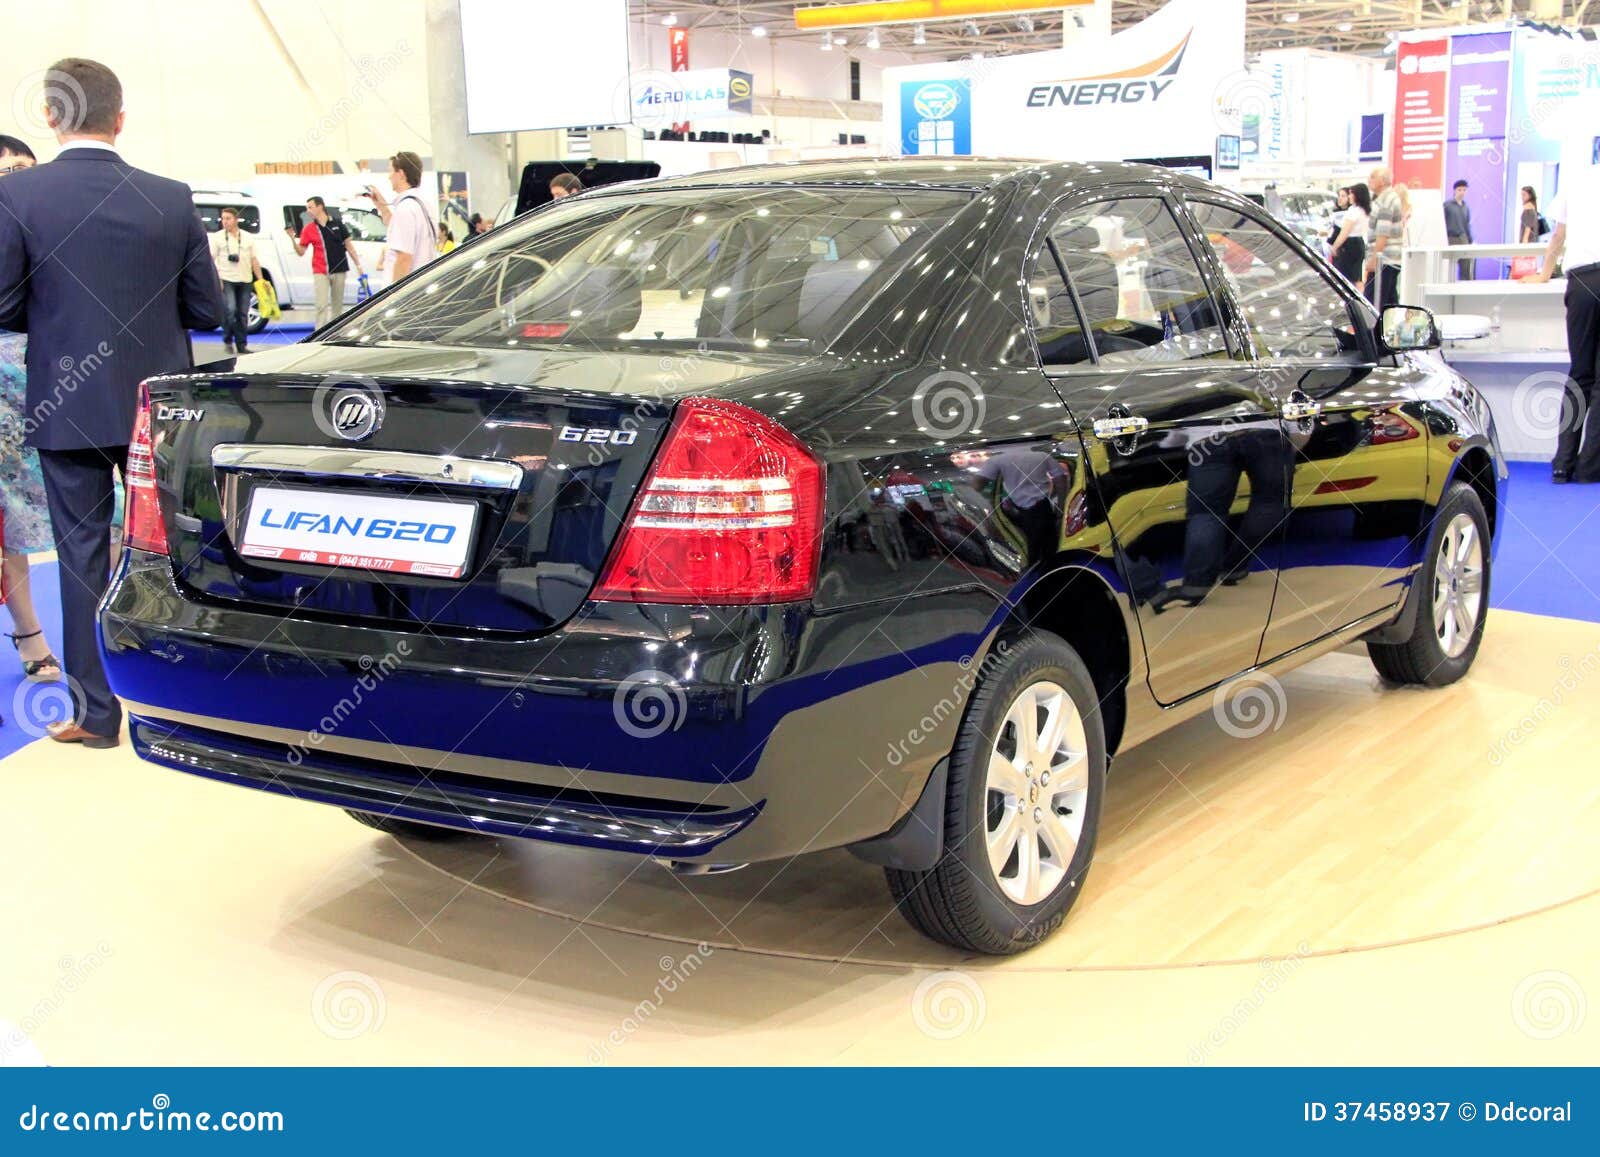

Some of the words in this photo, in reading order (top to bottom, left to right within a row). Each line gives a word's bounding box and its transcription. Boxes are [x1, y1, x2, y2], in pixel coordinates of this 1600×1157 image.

[1026, 79, 1174, 107] ENERGY
[157, 407, 205, 422] LIFAN
[558, 425, 638, 445] 620
[260, 508, 364, 537] LIFAN
[365, 519, 457, 544] 620
